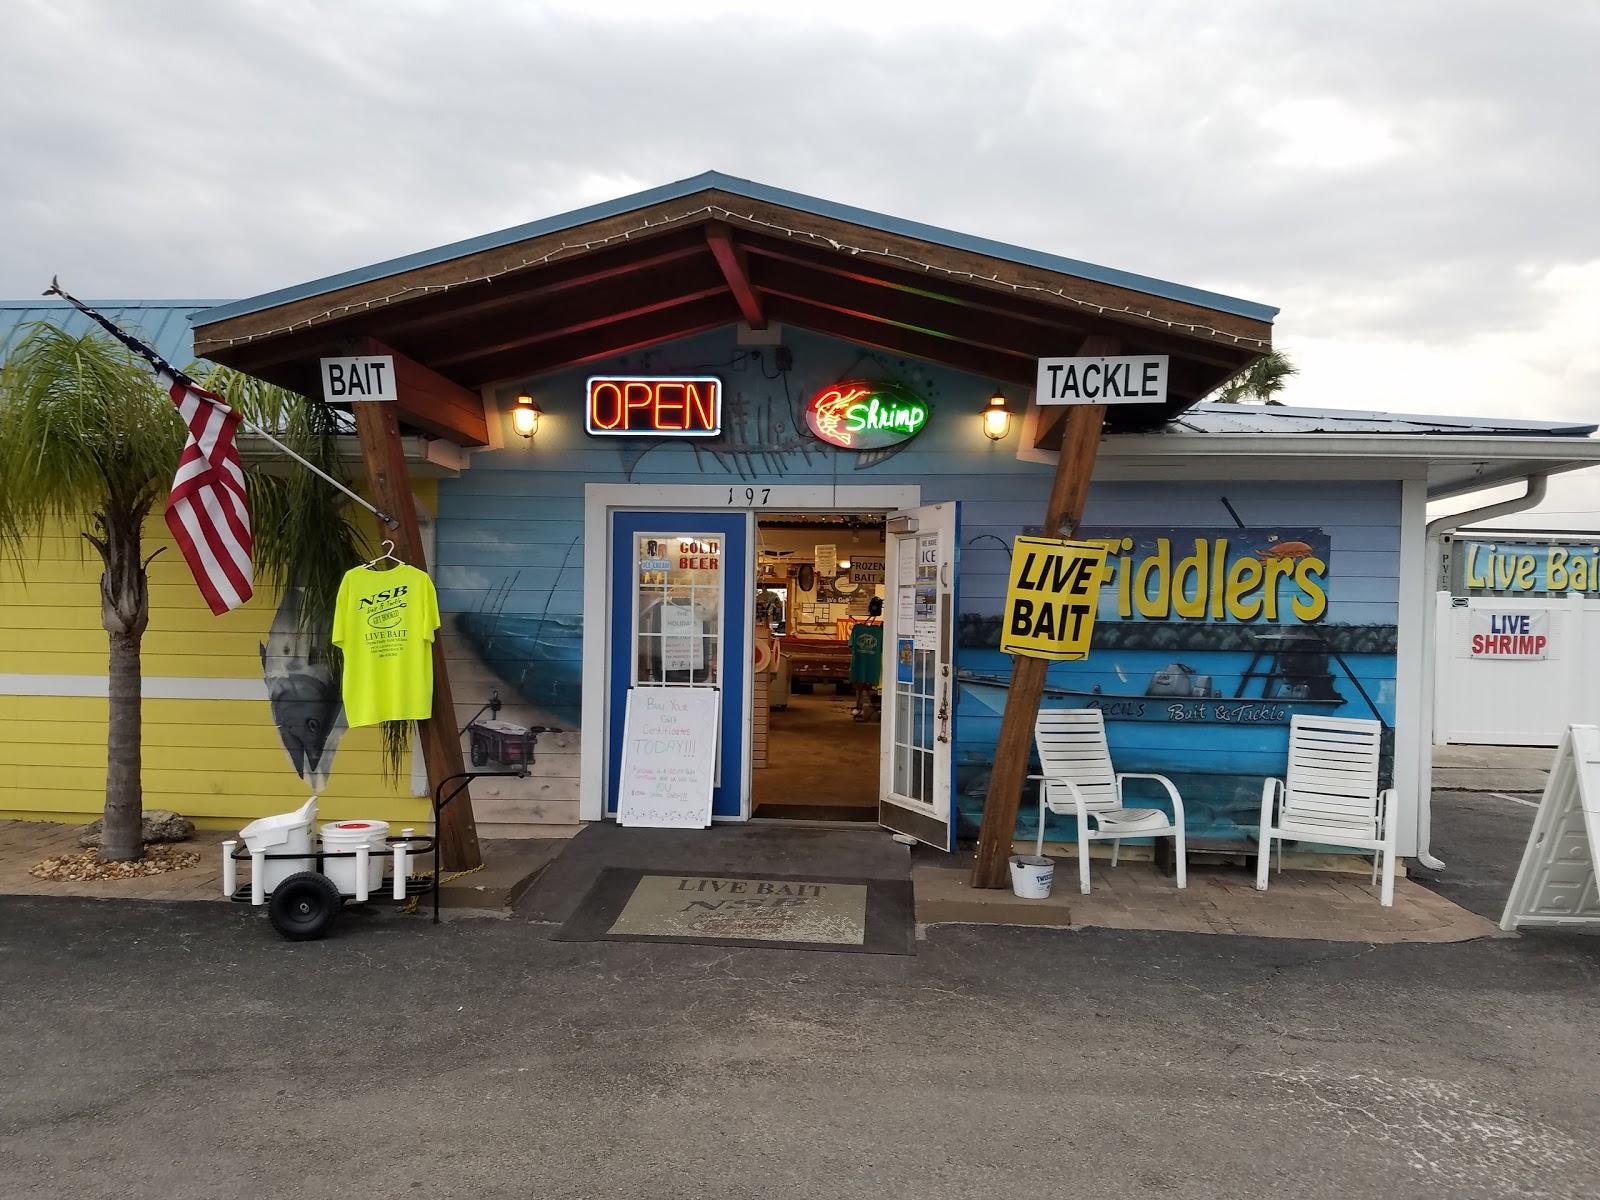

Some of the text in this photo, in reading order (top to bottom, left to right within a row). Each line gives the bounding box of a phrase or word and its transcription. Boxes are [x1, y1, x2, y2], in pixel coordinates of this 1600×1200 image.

[328, 362, 386, 396] BAIT
[1047, 362, 1160, 399] TACKLE
[592, 382, 716, 430] OPEN
[846, 398, 925, 433] Shrimp
[727, 486, 772, 506] 197
[679, 541, 719, 554] COLD
[922, 549, 936, 563] ICE
[679, 557, 719, 570] BEER
[851, 561, 885, 571] FROZEN
[1016, 552, 1099, 595] LIVE
[1466, 543, 1537, 591] Live
[855, 573, 877, 582] BAIT
[358, 585, 408, 610] NSB
[1011, 598, 1090, 642] BAIT
[1491, 614, 1531, 634] LIVE
[365, 629, 408, 641] LIVE BAIT
[1472, 634, 1547, 655] SHRIMP
[1167, 703, 1205, 720] Bait
[1214, 705, 1231, 721] &
[1231, 704, 1285, 721] Tackle
[677, 879, 828, 897] LIVE BAIT
